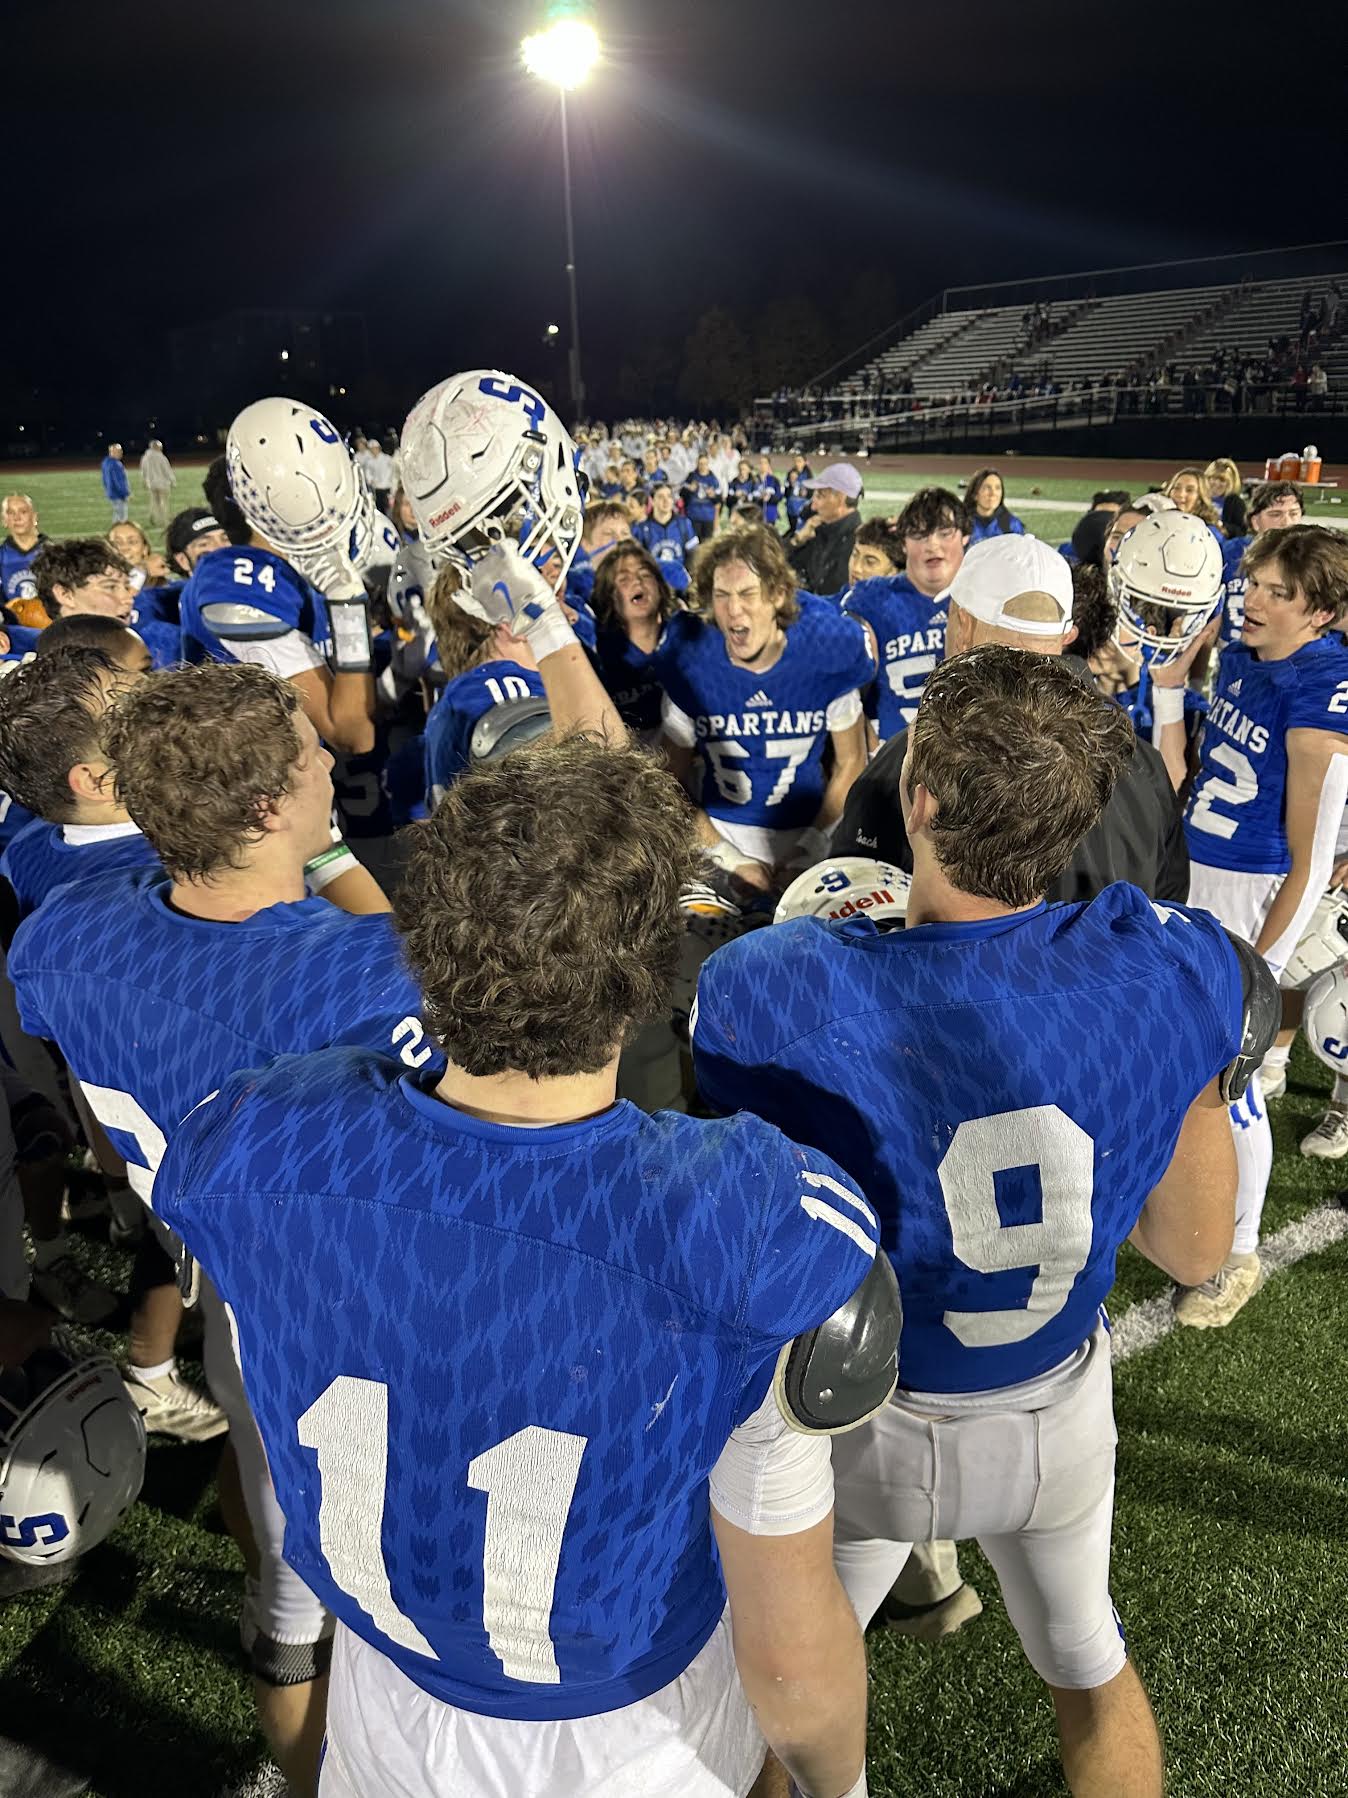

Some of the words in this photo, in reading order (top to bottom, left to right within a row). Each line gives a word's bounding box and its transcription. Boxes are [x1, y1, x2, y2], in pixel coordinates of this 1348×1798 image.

[233, 557, 276, 593] 24
[885, 628, 947, 660] SPAR
[484, 676, 530, 705] 10
[696, 710, 825, 737] SPARTANS
[705, 736, 817, 806] 67
[821, 870, 852, 893] 9
[391, 1016, 433, 1068] 2
[801, 1170, 877, 1260] 11
[937, 1104, 1095, 1348] 9
[297, 1374, 588, 1684] 11
